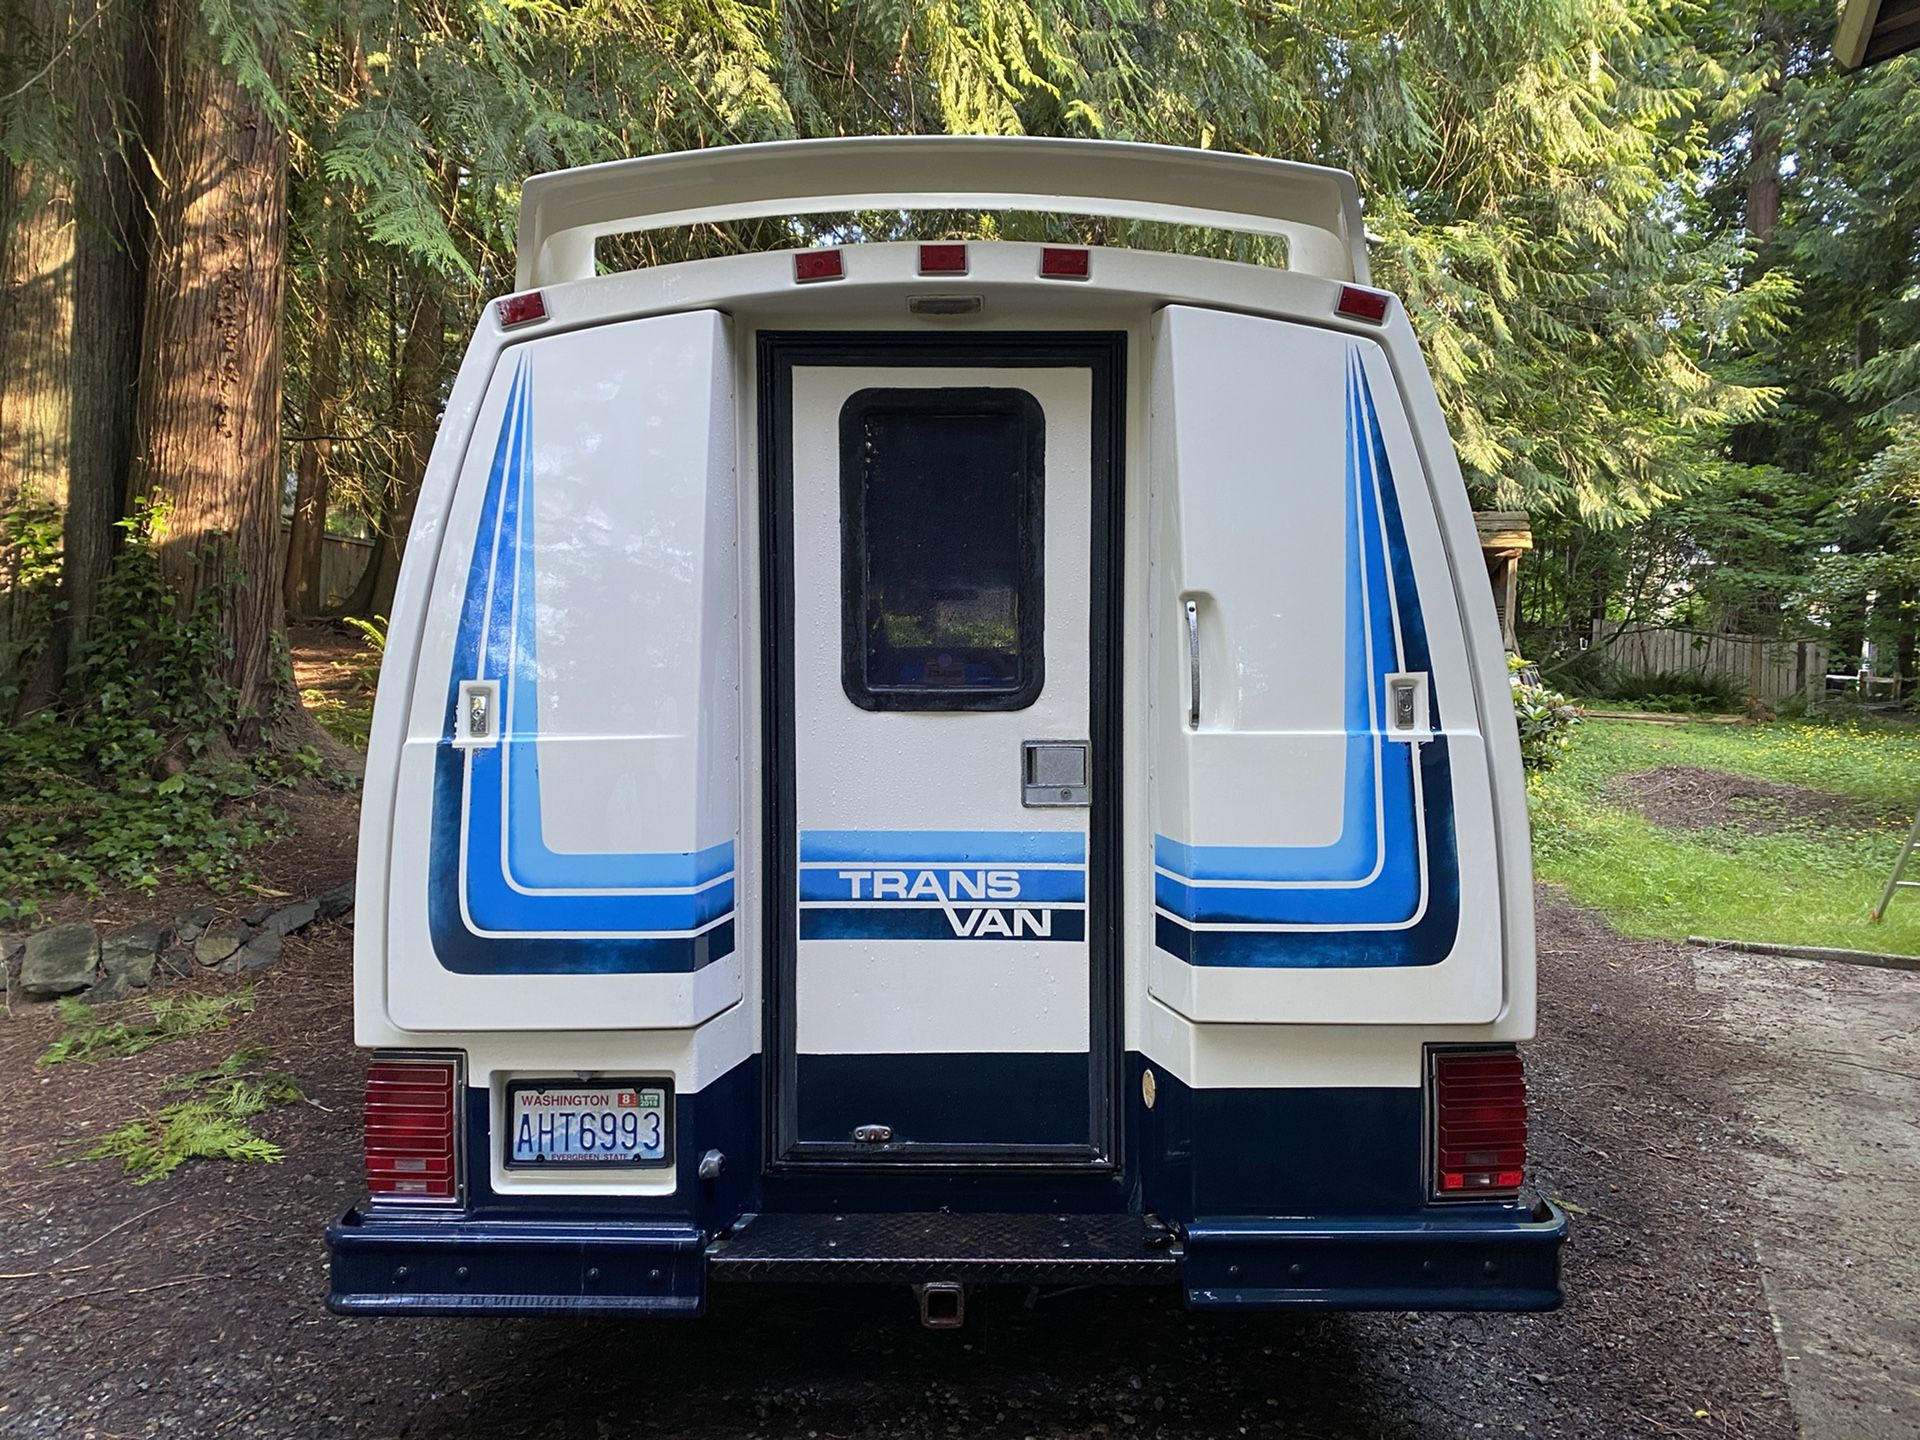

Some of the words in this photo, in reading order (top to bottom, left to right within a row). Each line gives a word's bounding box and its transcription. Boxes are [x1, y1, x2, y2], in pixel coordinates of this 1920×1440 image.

[838, 870, 1022, 899] TRANS
[945, 908, 1052, 937] VAN
[521, 1095, 609, 1107] WASHINGTON
[517, 1111, 660, 1153] AHT6993
[551, 1153, 600, 1161] EVERGREEN
[603, 1153, 628, 1161] STATE
